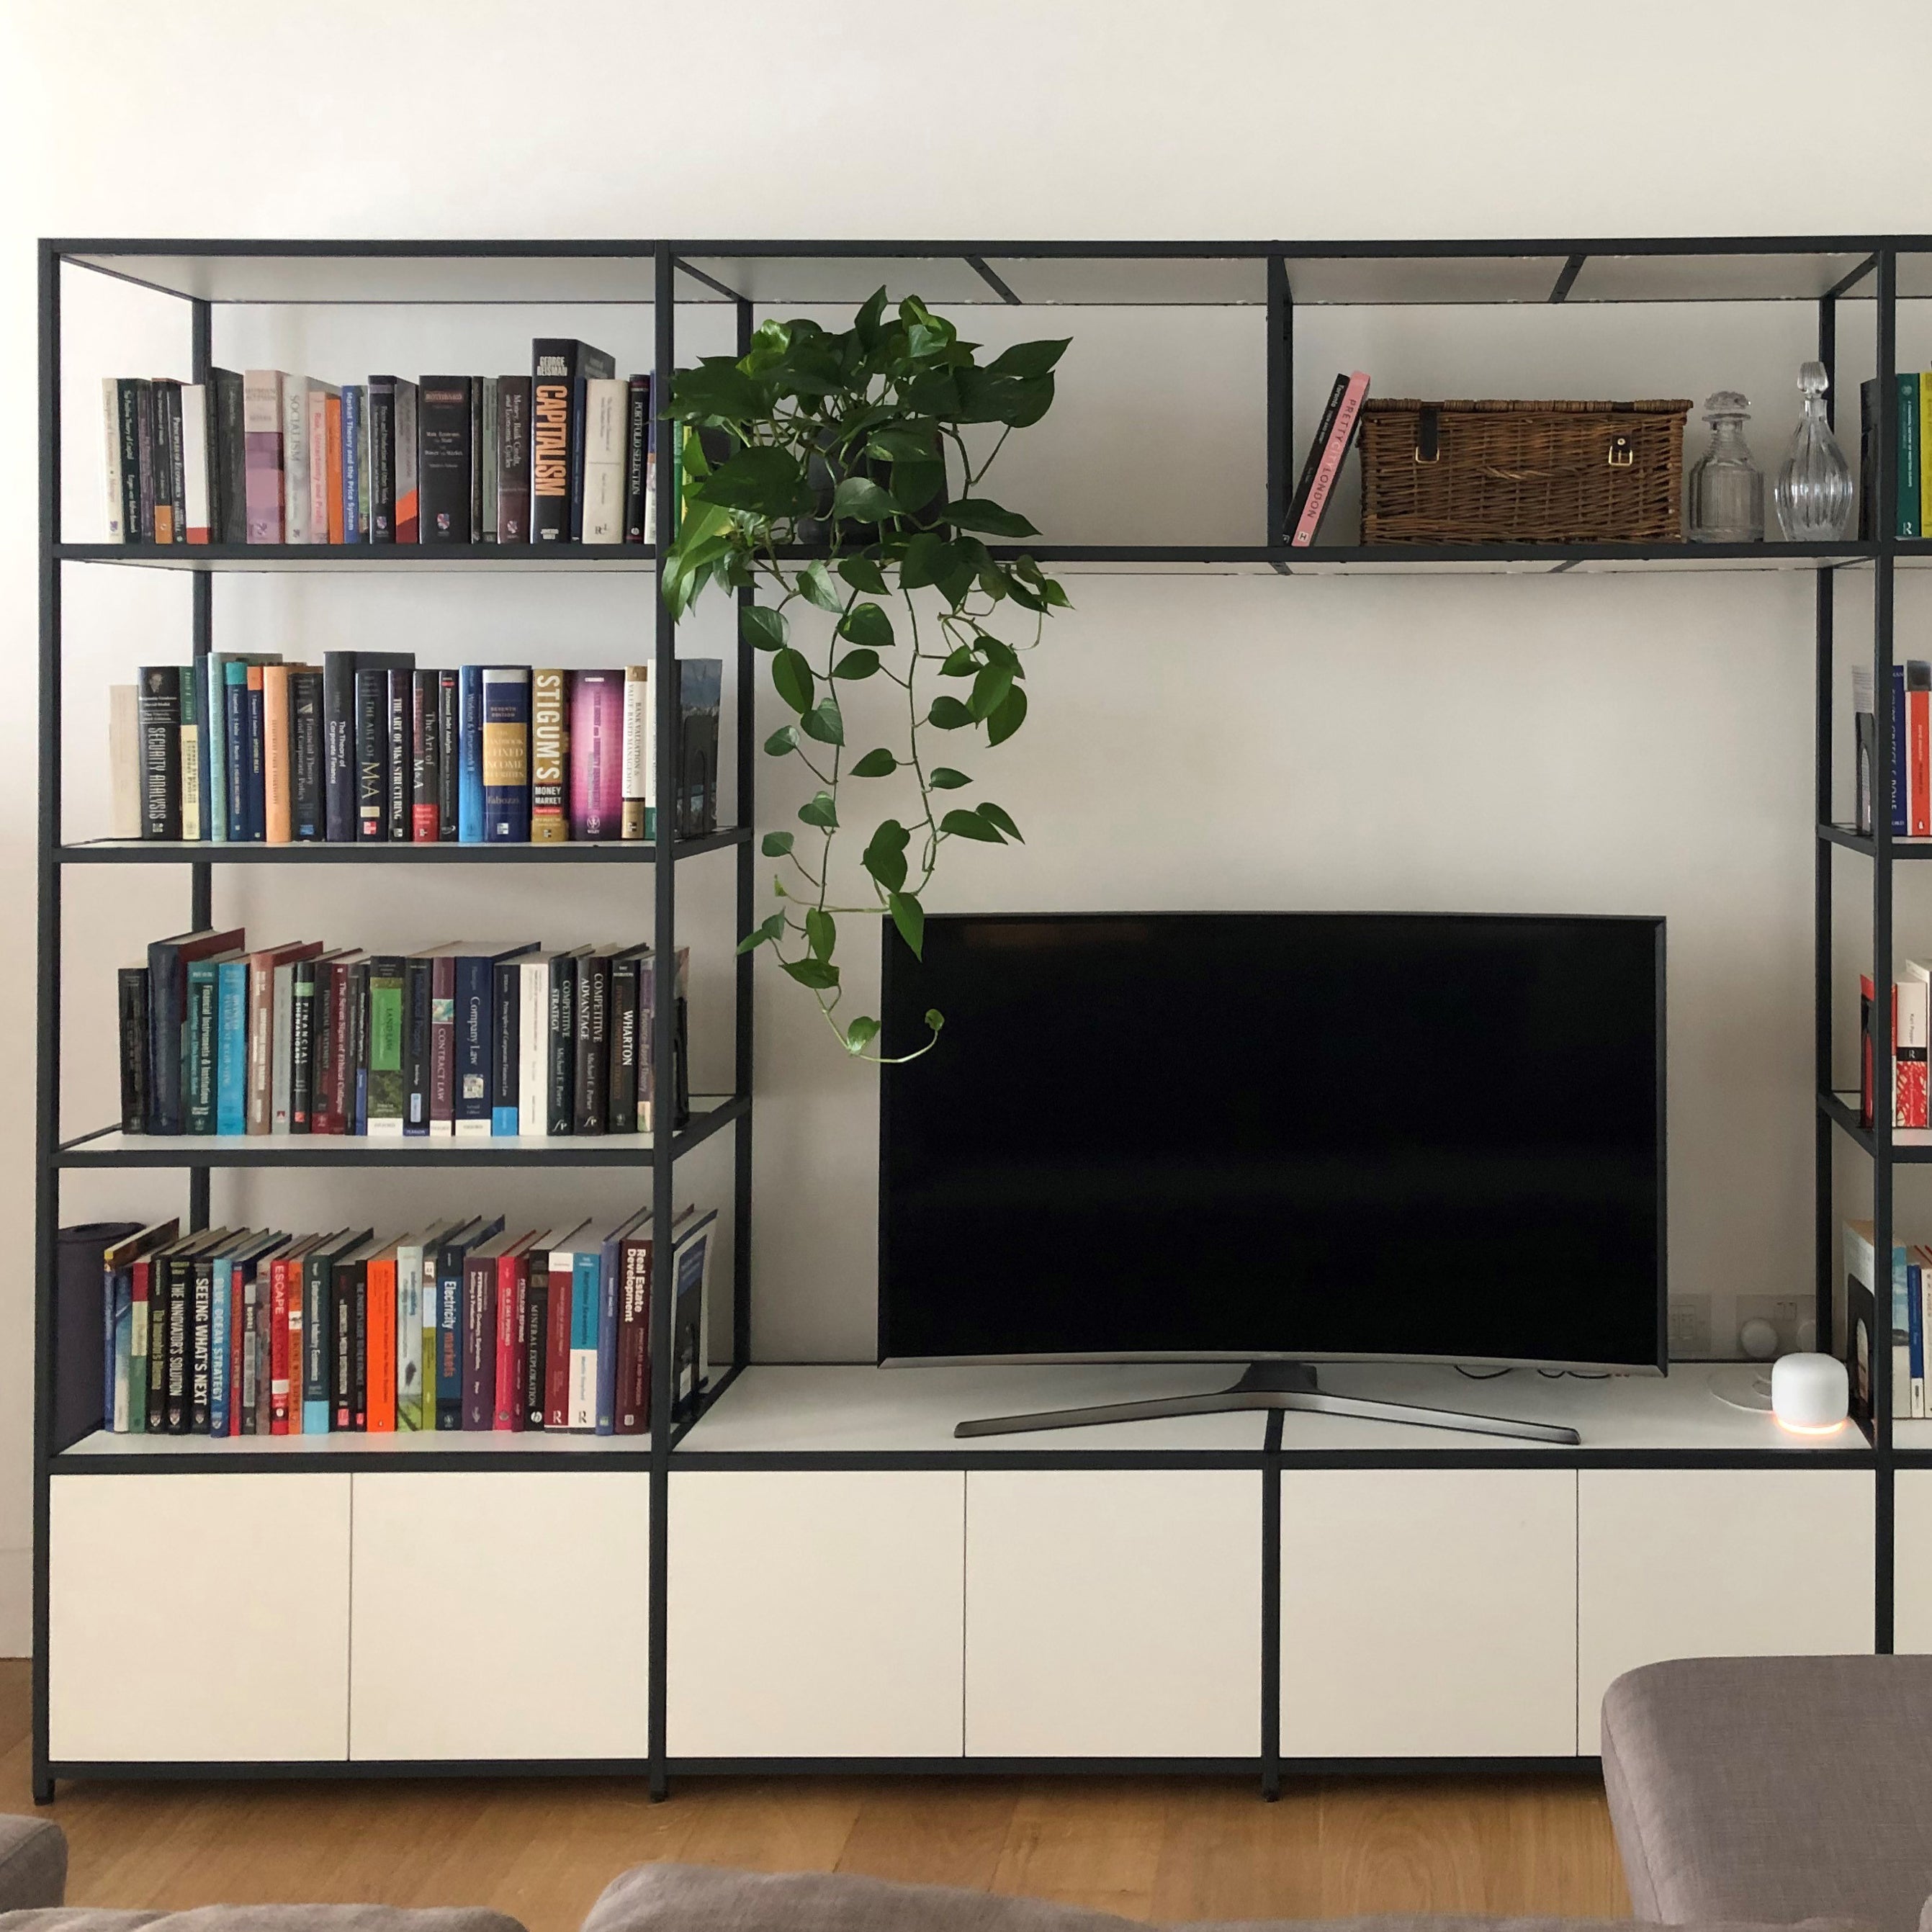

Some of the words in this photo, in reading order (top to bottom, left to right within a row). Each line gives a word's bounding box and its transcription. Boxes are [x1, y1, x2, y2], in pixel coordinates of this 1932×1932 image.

[1330, 385, 1344, 408] Toronto
[290, 395, 300, 462] SOCIALISM
[536, 385, 567, 496] CAPITALISM
[634, 402, 643, 448] PORTFOLIO
[1335, 399, 1357, 444] PRETTY
[632, 449, 642, 495] SELECTION
[1307, 469, 1332, 518] LONDON
[393, 698, 402, 714] THE
[393, 716, 402, 732] ART
[425, 711, 435, 731] The
[536, 675, 560, 779] STIGUM'S
[148, 727, 166, 771] SECURITY
[393, 734, 402, 742] OF
[425, 734, 435, 751] Art
[414, 759, 423, 788] M&A
[426, 755, 435, 766] of
[148, 775, 166, 819] ANALYSIS
[297, 778, 305, 801] Policy
[393, 767, 402, 819] STRUCTURING
[535, 786, 561, 796] MONEY
[202, 985, 212, 1015] Financial
[467, 997, 480, 1043] Company
[562, 980, 570, 1038] COMPETITIVE
[580, 978, 589, 1041] ADVANTAGE
[593, 973, 603, 1043] COMPETITIVE
[202, 1017, 212, 1057] Instruments
[470, 1046, 480, 1065] Law
[622, 1010, 633, 1066] WHARTON
[200, 1066, 210, 1104] Institutions
[639, 1068, 650, 1092] Theory
[637, 1249, 646, 1273] Real
[171, 1283, 184, 1298] THE
[196, 1278, 209, 1321] SEEING
[214, 1278, 224, 1304] BLUE
[274, 1266, 284, 1315] ESCAPE
[311, 1281, 320, 1323] Entertainment
[442, 1281, 457, 1329] Electricity
[624, 1249, 636, 1322] Development
[635, 1277, 645, 1312] Estate
[153, 1310, 164, 1321] The
[170, 1300, 184, 1354] INNOVATOR'S
[214, 1308, 224, 1344] OCEAN
[194, 1325, 208, 1371] WHAT'S
[311, 1349, 320, 1381] Economics
[444, 1331, 456, 1377] markets
[169, 1357, 182, 1396] SOLUTION
[194, 1375, 207, 1406] NEXT
[213, 1348, 223, 1401] STRATEGY
[529, 1349, 538, 1406] EXPLORATION
